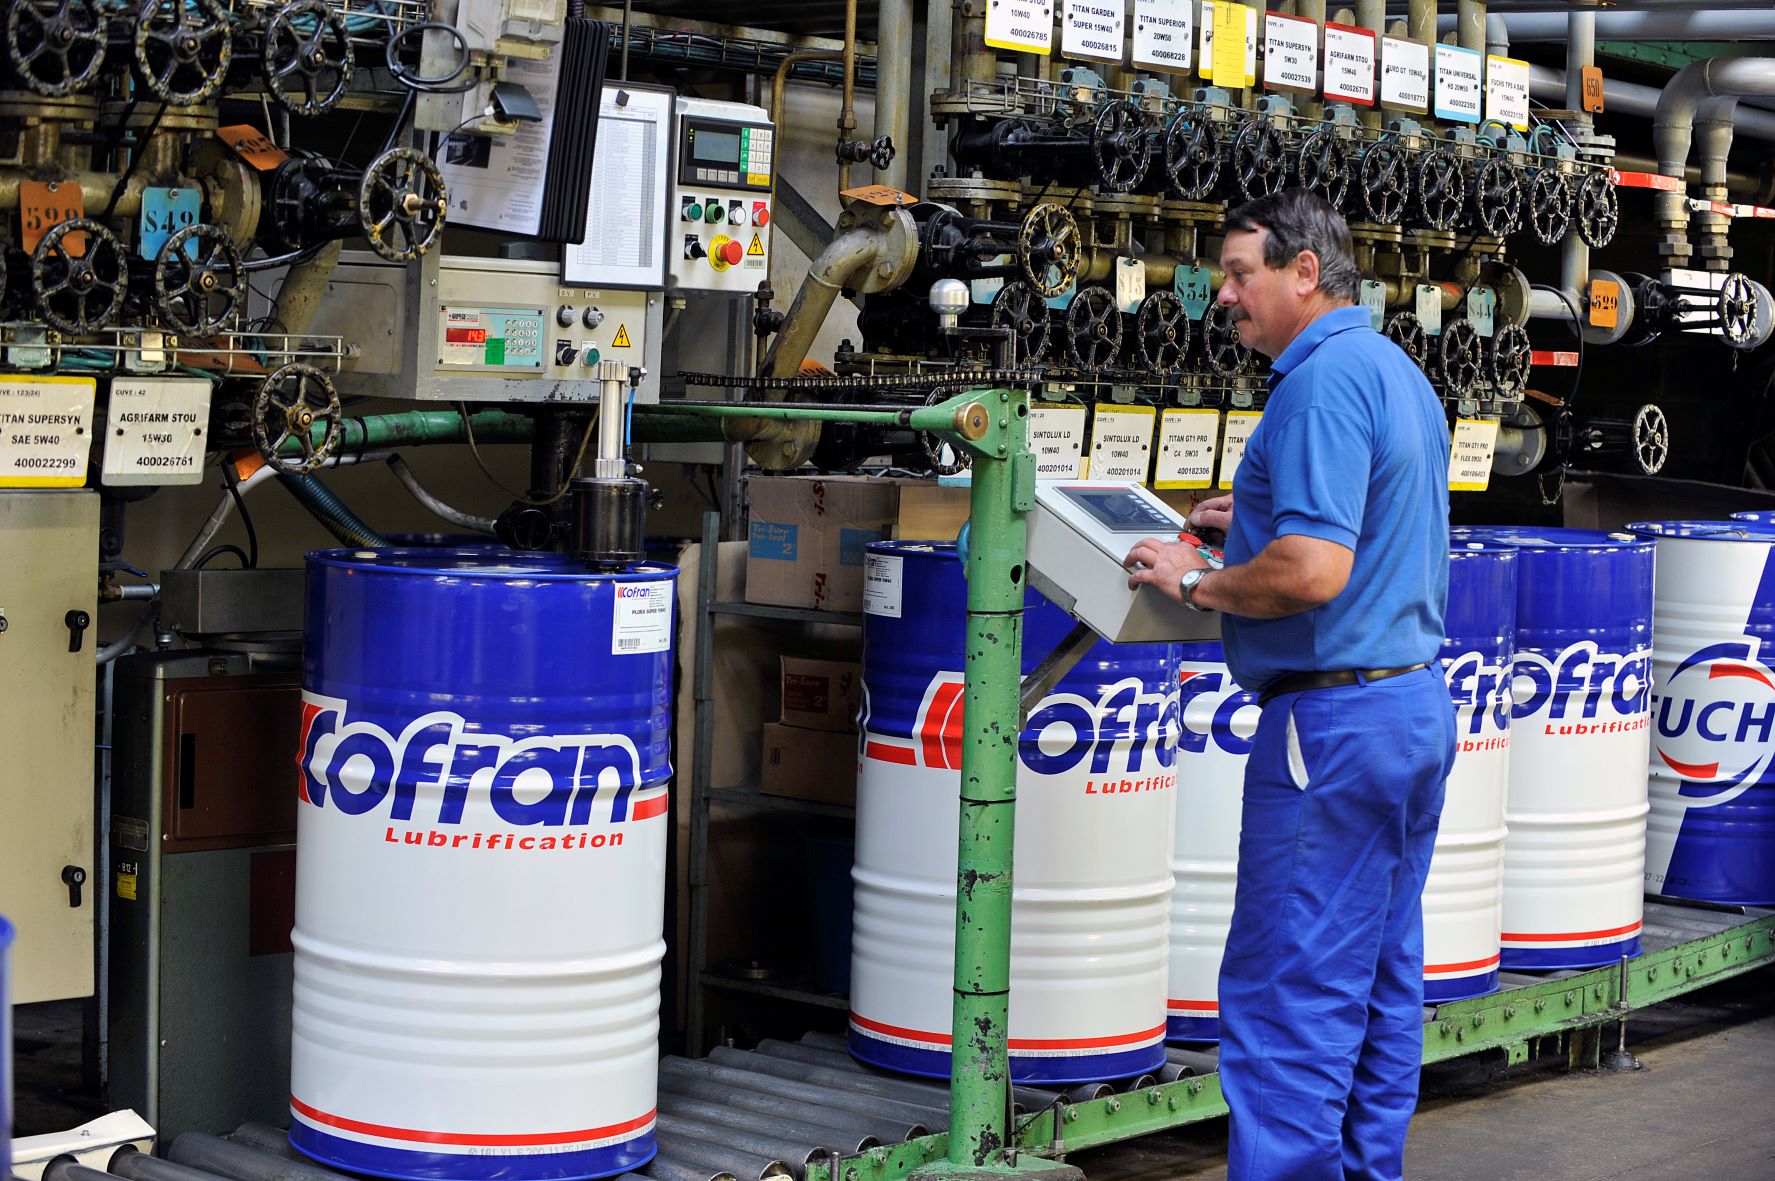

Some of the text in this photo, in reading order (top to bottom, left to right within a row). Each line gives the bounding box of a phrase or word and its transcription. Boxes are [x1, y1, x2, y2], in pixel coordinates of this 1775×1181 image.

[1011, 9, 1031, 19] 10W40
[1072, 4, 1115, 18] TITAN GARDEN
[1073, 20, 1113, 34] SUPER 15W40
[1140, 15, 1186, 28] TITAN SUPERIOR
[1010, 28, 1048, 41] 400026785
[1153, 32, 1172, 42] 20W50
[1081, 40, 1117, 52] 400026815
[1269, 38, 1312, 52] TITAN SUPERSYN
[1151, 50, 1186, 61] 400068228
[1284, 55, 1298, 65] 5W30
[1330, 51, 1369, 64] AGRIFARM STOU
[1400, 67, 1406, 75] GT
[1439, 67, 1477, 81] TITAN UNIVERSAL
[1281, 72, 1312, 84] 400027539
[1340, 83, 1369, 95] 400026778
[1490, 78, 1505, 88] FUCHS
[1516, 84, 1525, 92] SAE
[1586, 77, 1600, 98] 650
[1398, 91, 1426, 103] 400018773
[1449, 99, 1476, 110] 400022350
[1594, 294, 1618, 311] 529
[28, 414, 81, 424] SUPERSYN
[120, 413, 197, 423] AGRIFARM STOU
[12, 435, 60, 445] SAE 5W40
[1033, 431, 1071, 439] SINTOLUX LD
[1103, 435, 1131, 443] SINTOLUX
[1228, 436, 1244, 444] TITAN
[1041, 446, 1060, 454] 10W40
[1111, 450, 1129, 458] 10W40
[14, 458, 76, 469] 400022299
[136, 456, 194, 466] 400026761
[1037, 464, 1073, 472] 400201014
[1106, 467, 1141, 476] 400201014
[1177, 467, 1210, 475] 400182306
[782, 543, 792, 555] 2
[622, 586, 650, 598] Cofran
[813, 695, 823, 707] 2
[1018, 686, 1180, 776] ofra
[303, 708, 637, 826] Cofran
[385, 827, 624, 851] Lubrification
